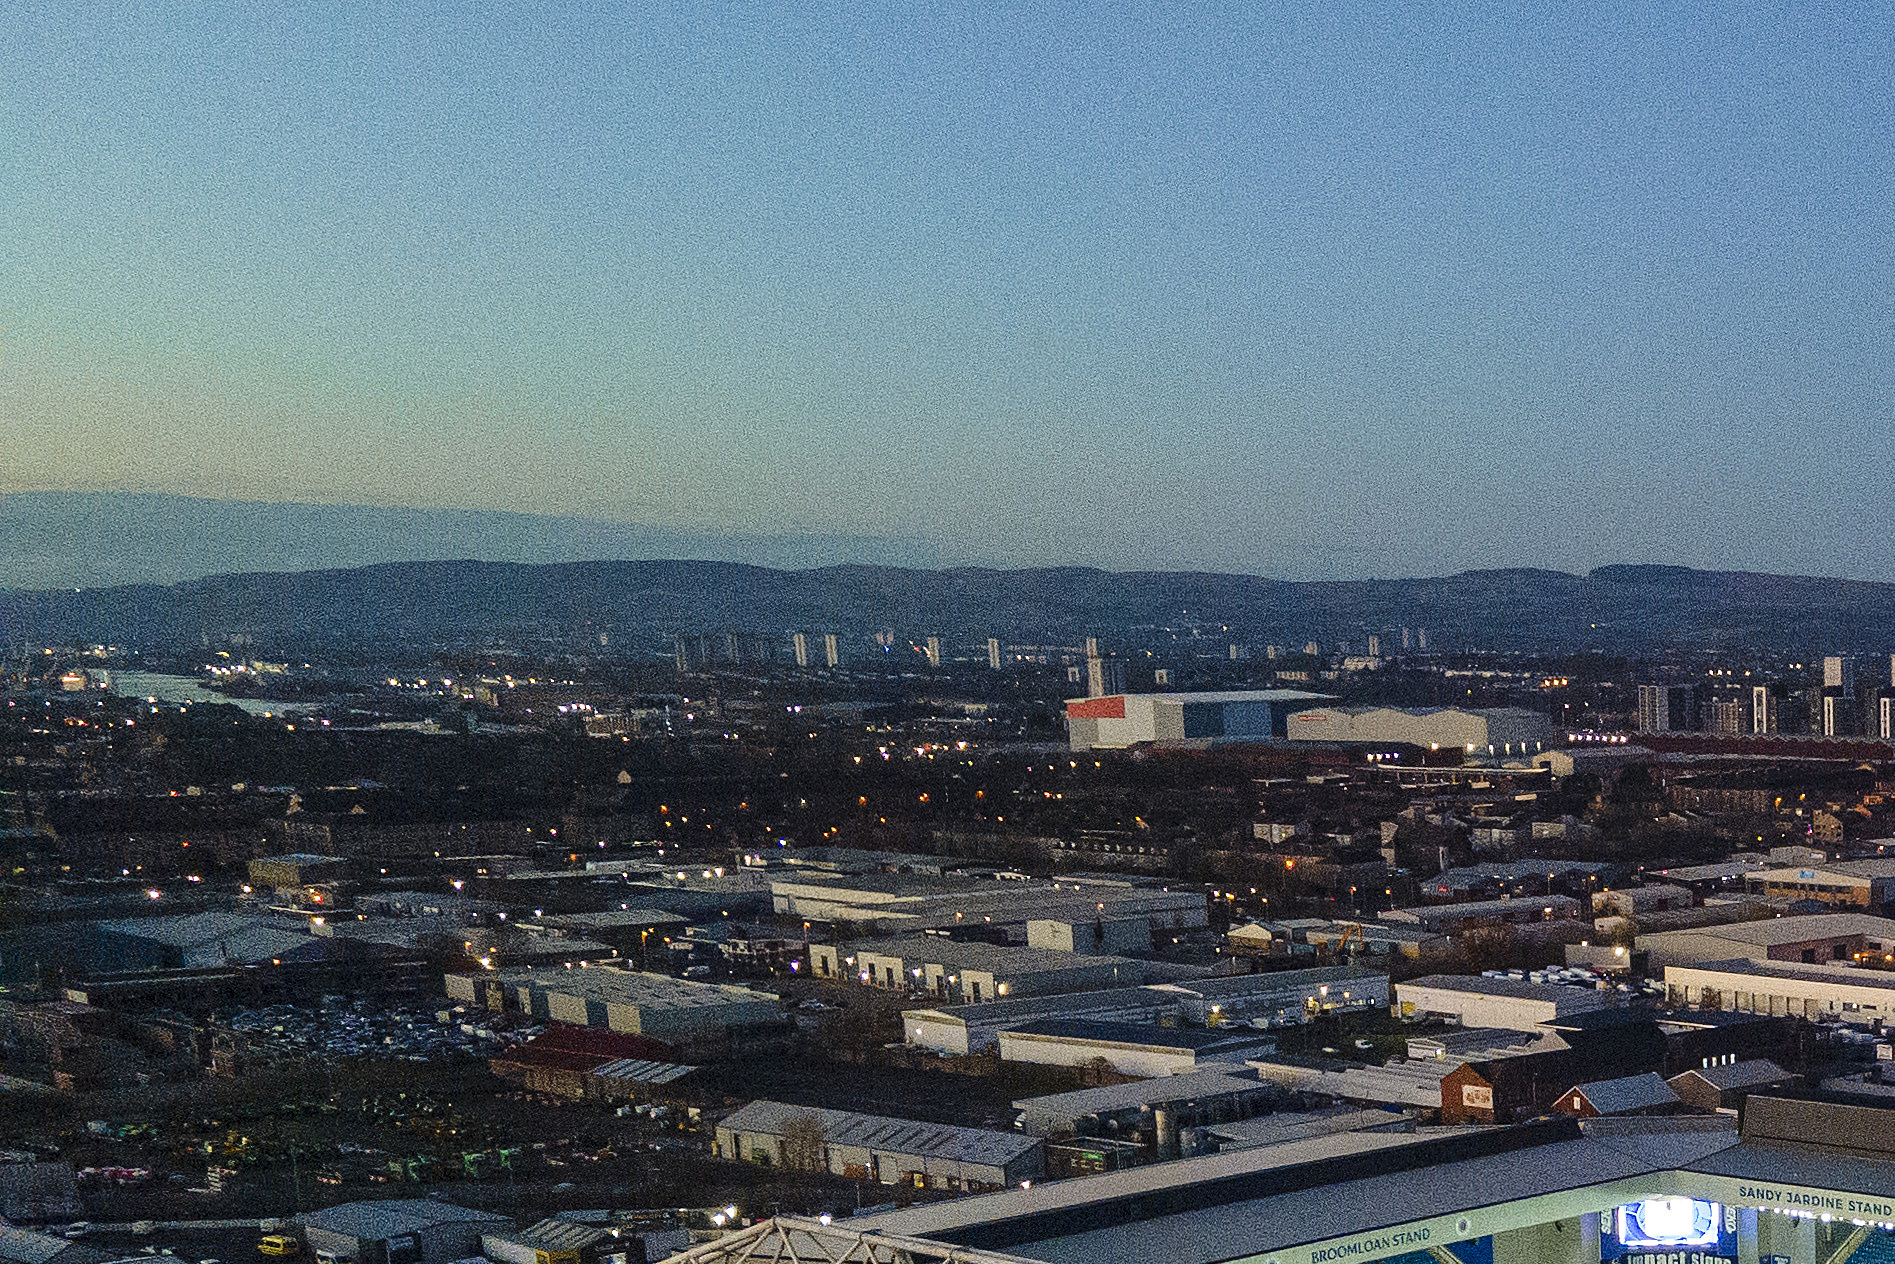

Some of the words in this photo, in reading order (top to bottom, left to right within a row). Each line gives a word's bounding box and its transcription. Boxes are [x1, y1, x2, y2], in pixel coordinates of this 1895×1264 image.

[1739, 1186, 1782, 1201] SANDY
[1786, 1192, 1843, 1210] JARDINE
[1848, 1200, 1893, 1216] STAND
[1311, 1237, 1390, 1264] BROOMLOAN
[1392, 1228, 1430, 1246] STAND
